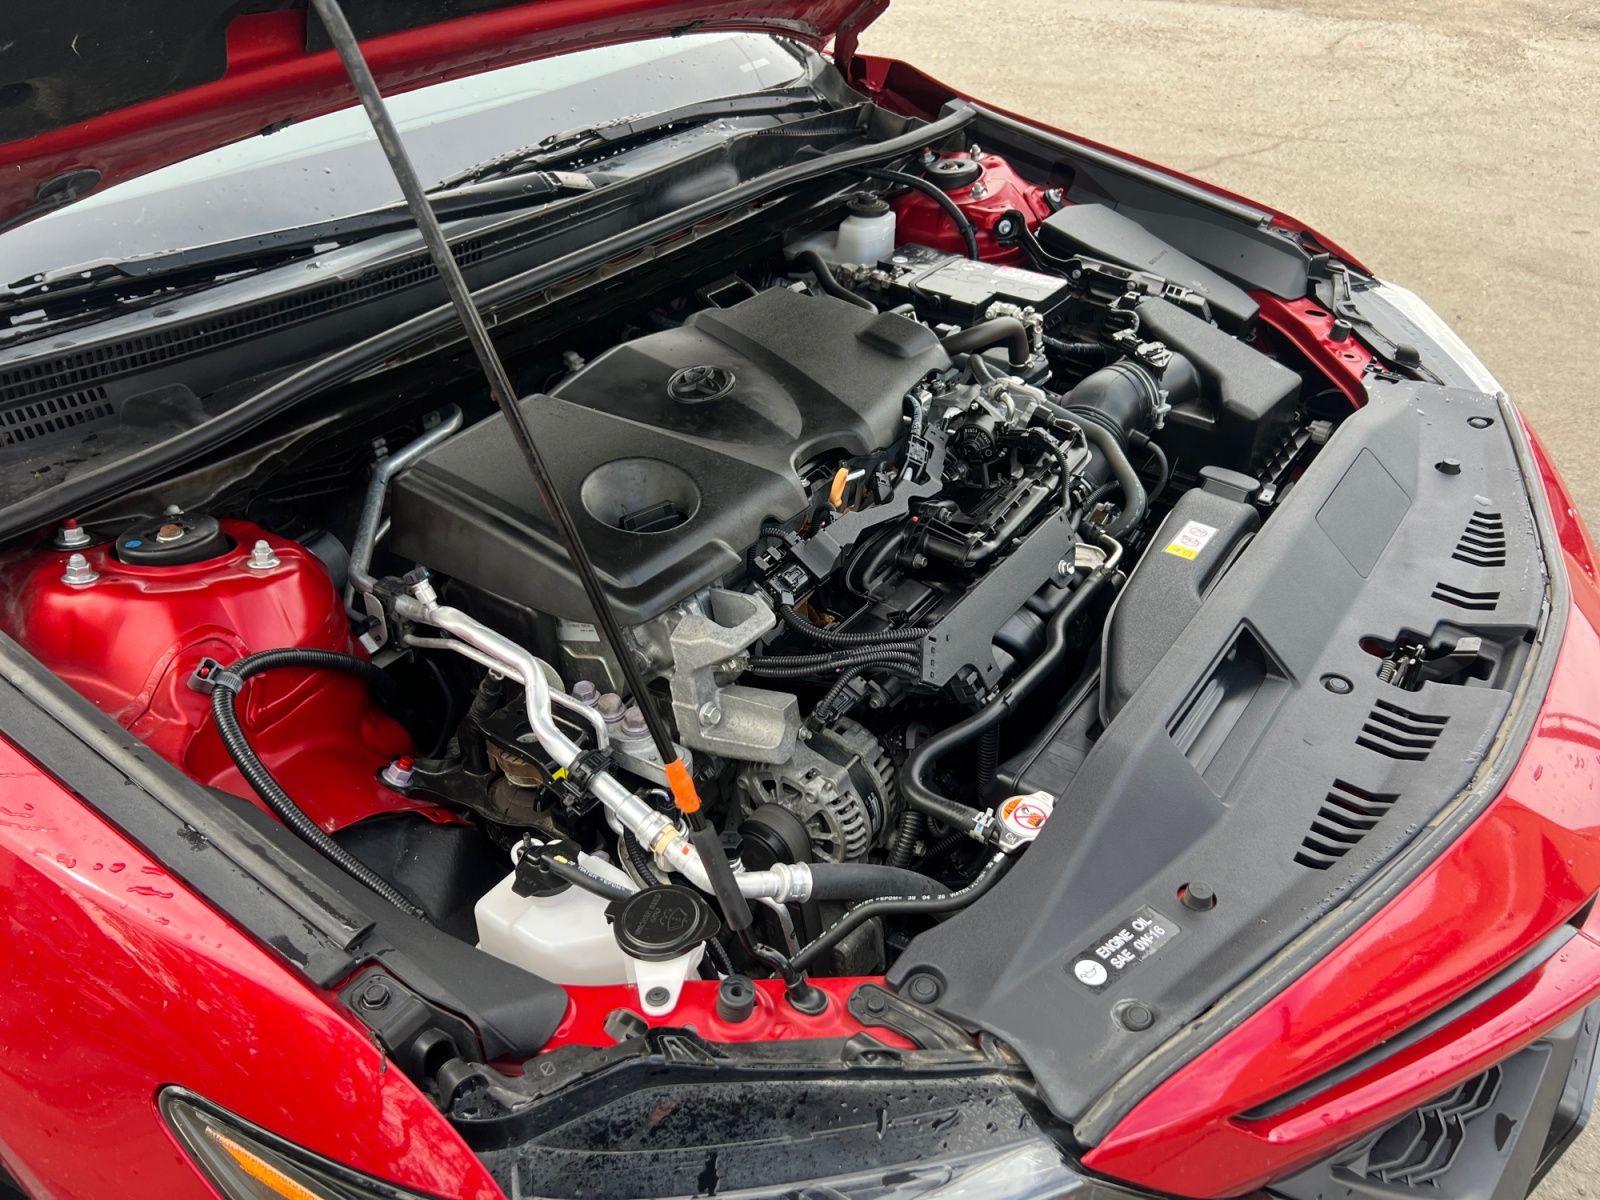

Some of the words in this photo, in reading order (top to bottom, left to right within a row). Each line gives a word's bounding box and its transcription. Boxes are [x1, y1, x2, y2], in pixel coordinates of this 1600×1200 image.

[1096, 928, 1135, 959] ENGINE
[1131, 916, 1153, 931] OIL
[1110, 948, 1136, 969] SAE
